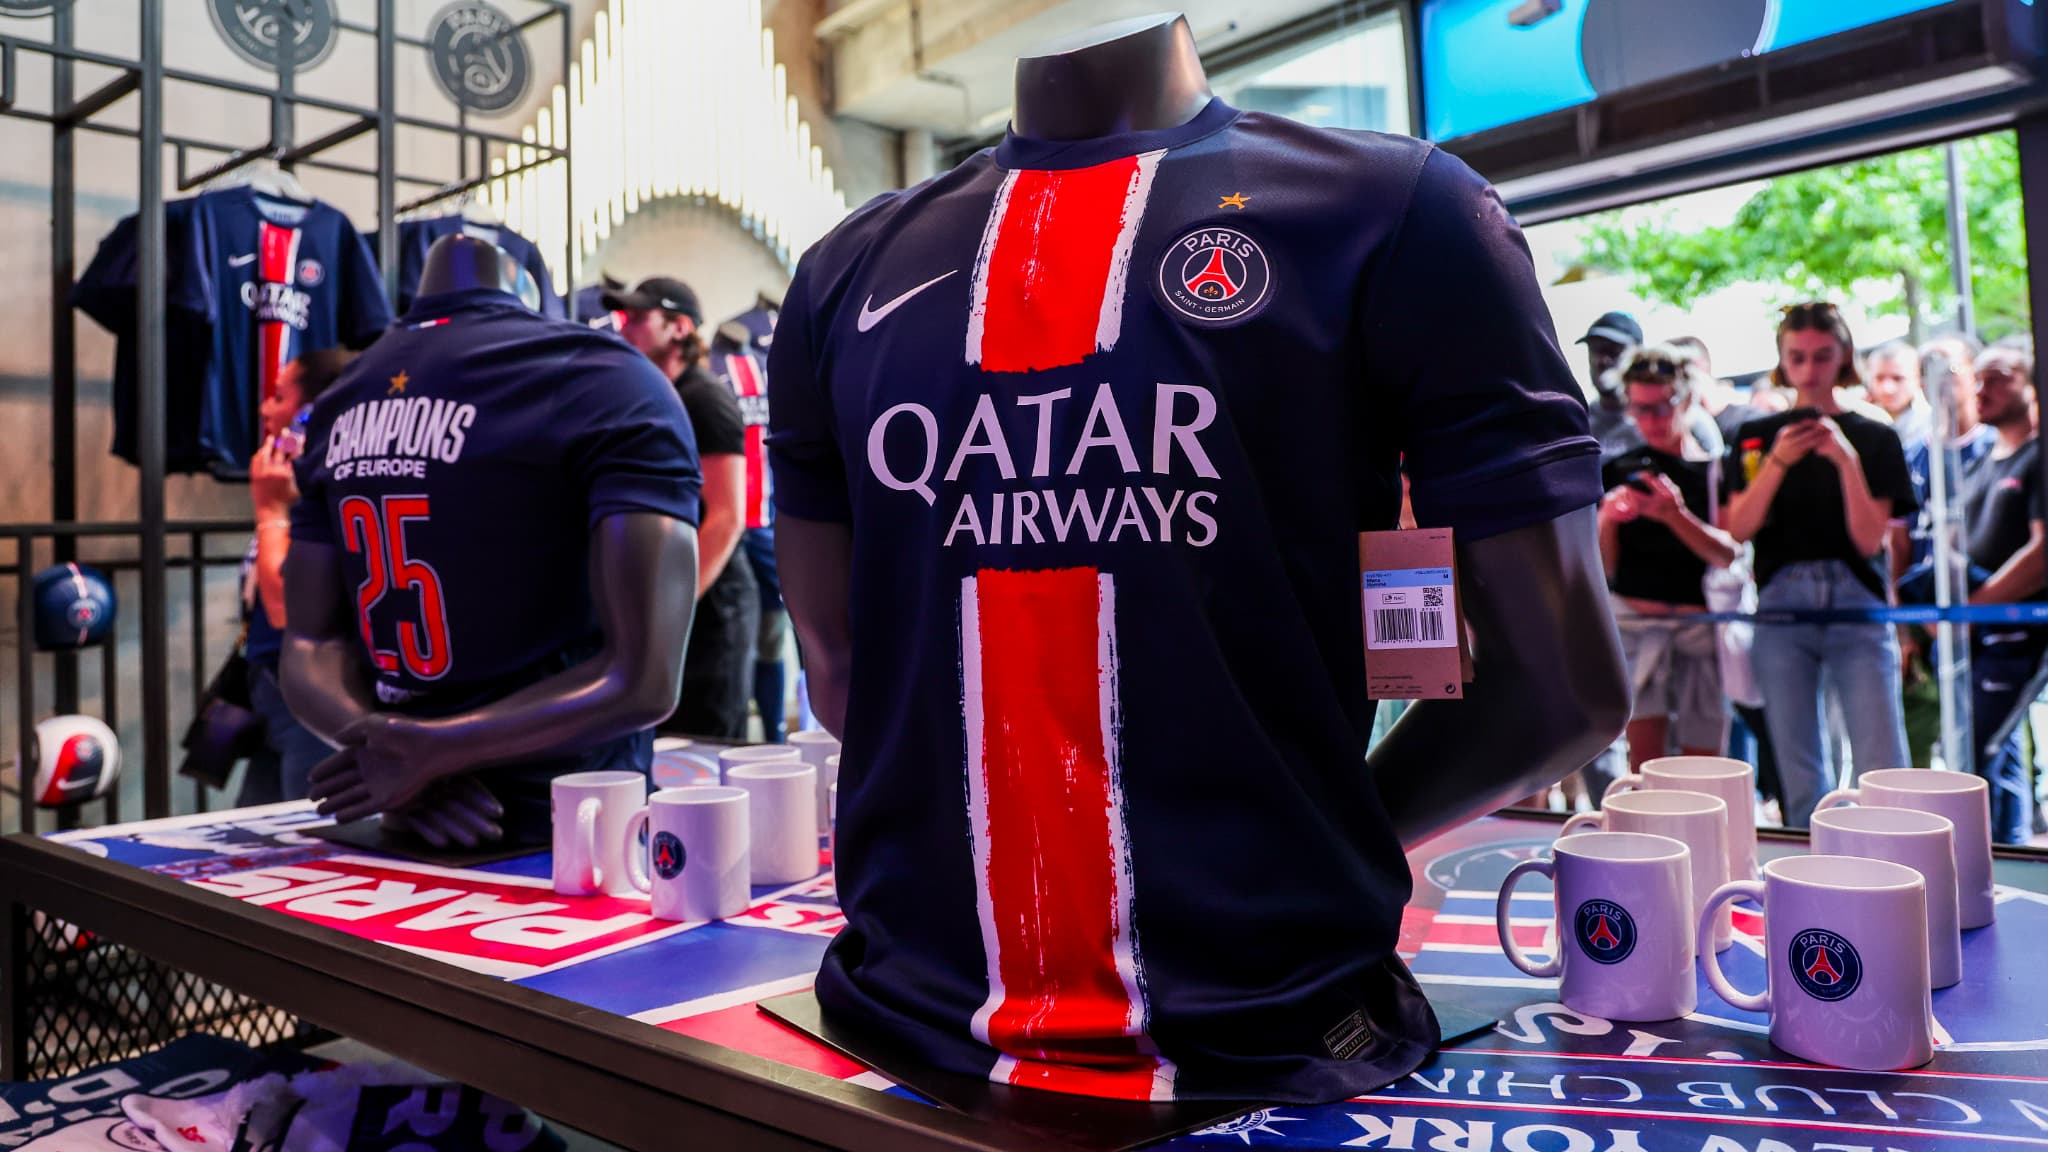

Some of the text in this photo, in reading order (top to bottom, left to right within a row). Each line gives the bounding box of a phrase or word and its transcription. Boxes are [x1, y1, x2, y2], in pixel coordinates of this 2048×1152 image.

[1183, 232, 1254, 258] PARIS
[325, 396, 477, 468] CHAMPIONS
[867, 383, 1222, 507] QATAR
[334, 459, 427, 481] OF EUROPE
[943, 487, 1218, 547] AIRWAYS
[339, 495, 453, 681] 25
[205, 866, 653, 951] PARIS
[1584, 904, 1623, 921] PARIS
[1800, 934, 1846, 953] PARIS
[1386, 1067, 1643, 1102] CHIN
[1677, 1081, 1982, 1125] CLUB
